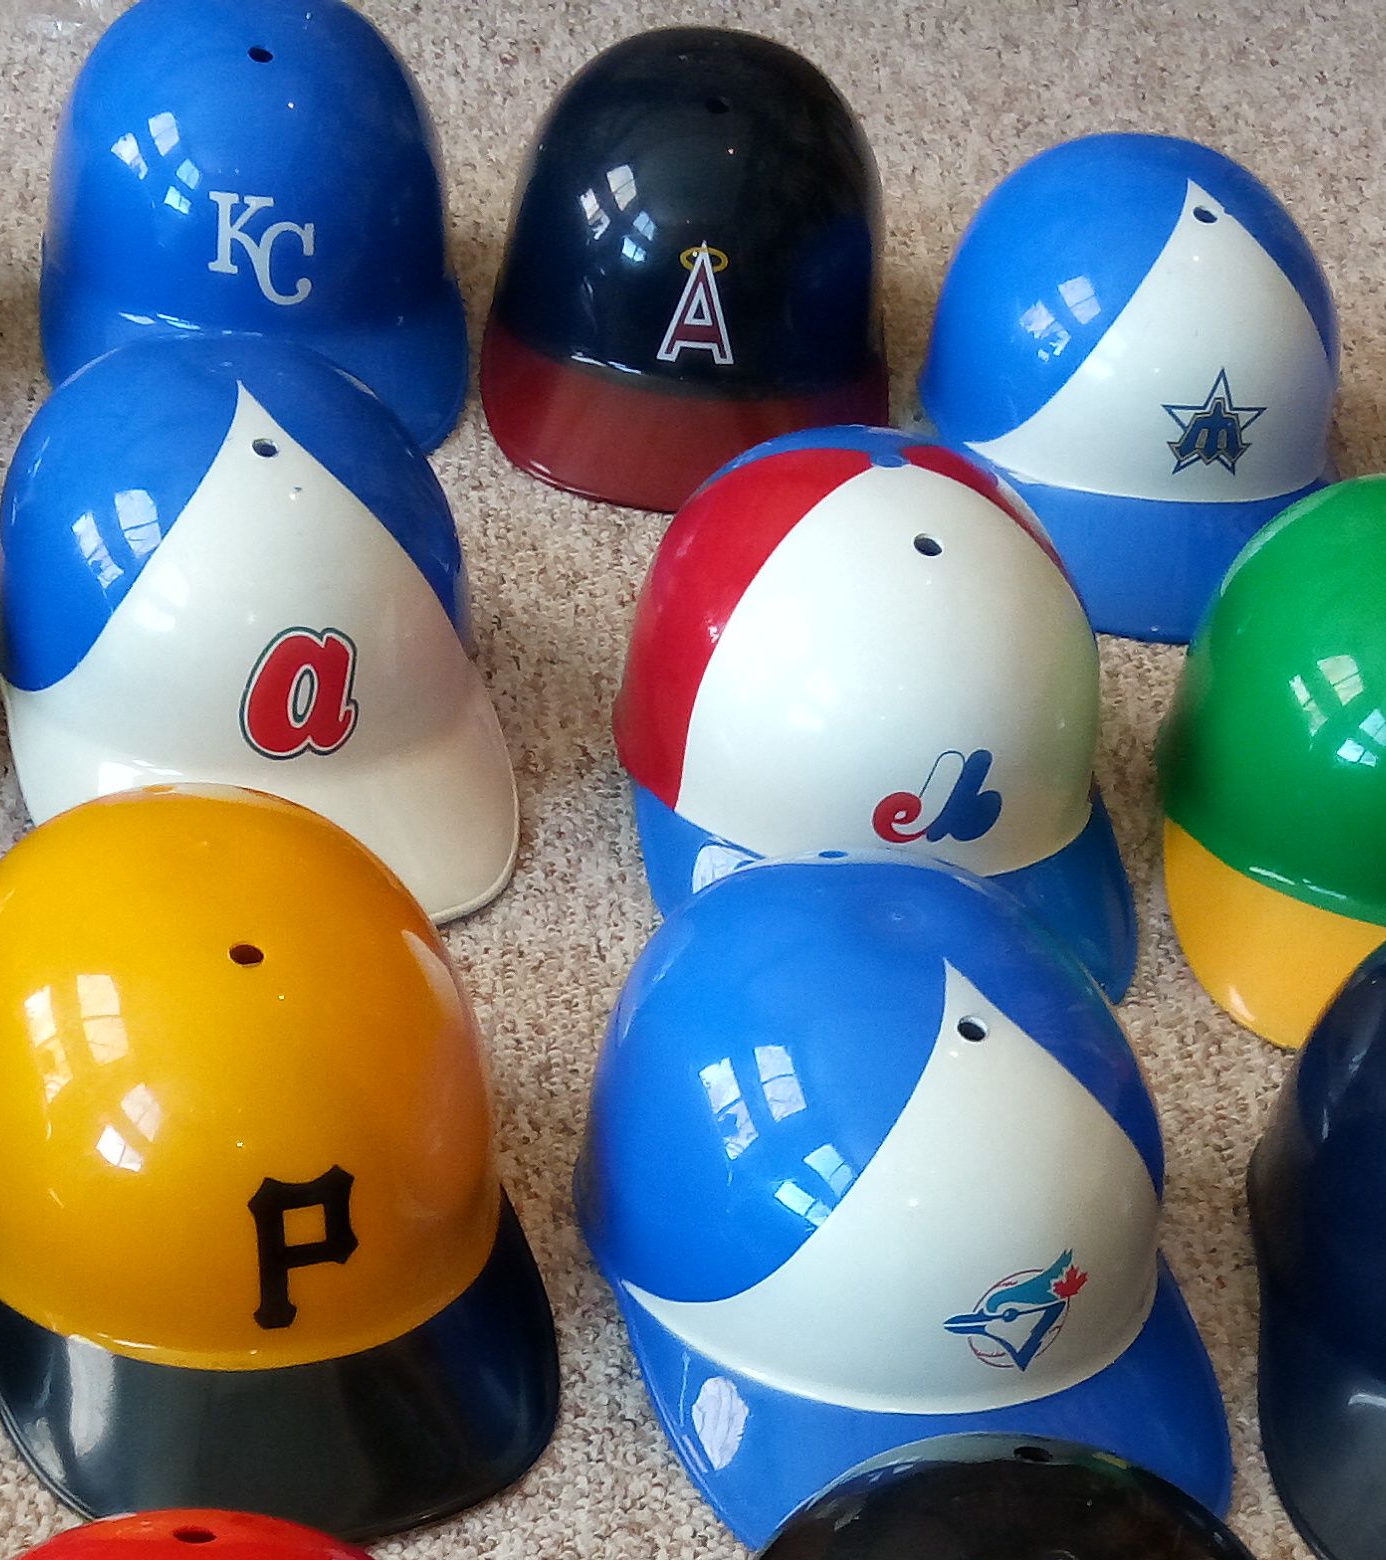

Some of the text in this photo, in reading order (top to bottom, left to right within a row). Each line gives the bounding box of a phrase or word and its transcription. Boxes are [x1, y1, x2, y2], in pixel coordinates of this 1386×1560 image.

[209, 191, 314, 305] KC
[656, 242, 734, 364] A
[249, 1165, 358, 1330] P
